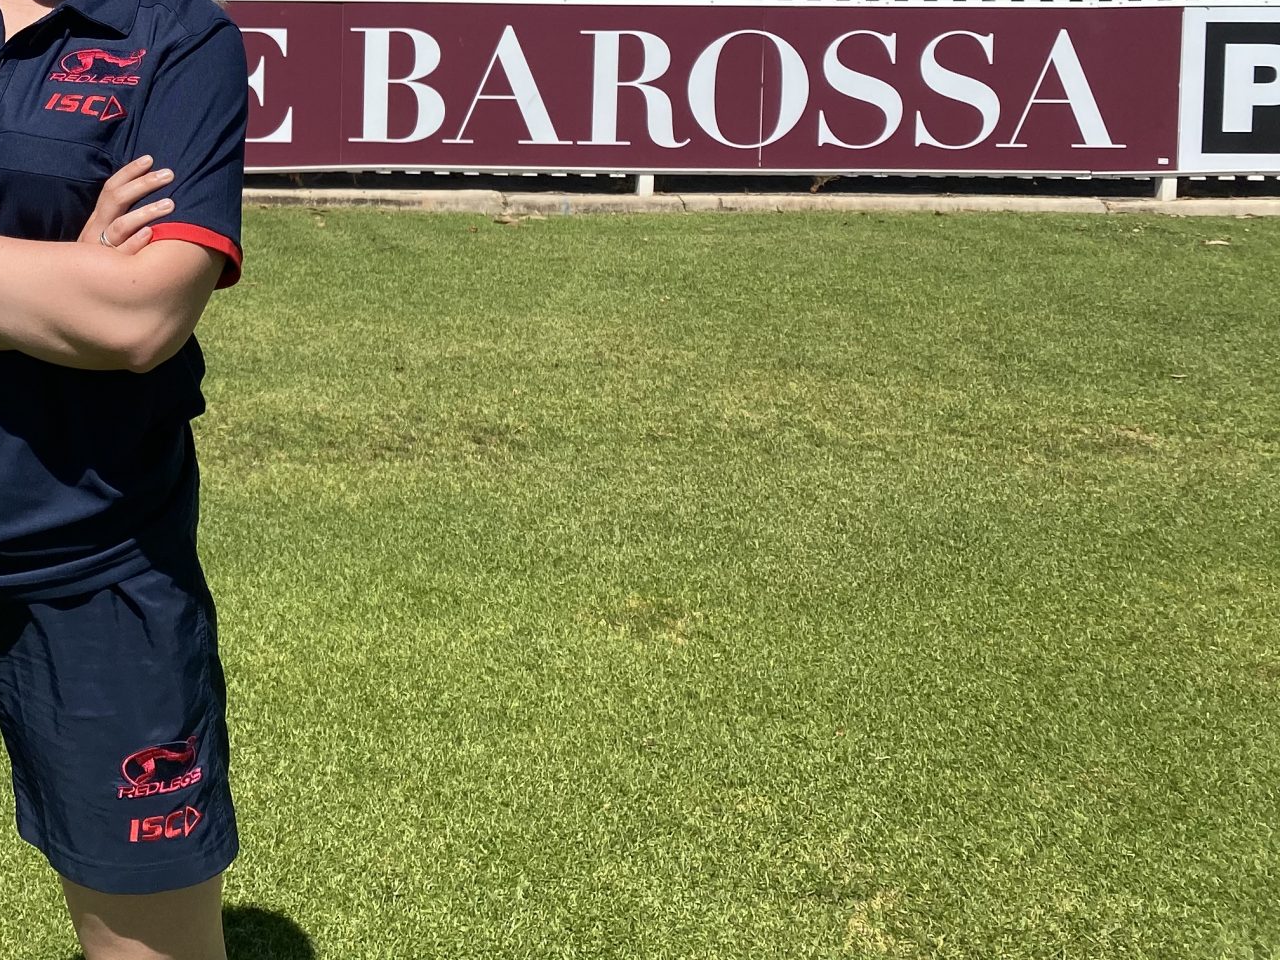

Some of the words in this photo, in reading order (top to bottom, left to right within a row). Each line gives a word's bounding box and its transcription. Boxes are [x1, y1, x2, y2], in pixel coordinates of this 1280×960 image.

[49, 71, 141, 87] REDLEGS
[347, 24, 1127, 150] BAROSSA
[1221, 43, 1280, 133] P
[117, 767, 203, 800] REDLEGS
